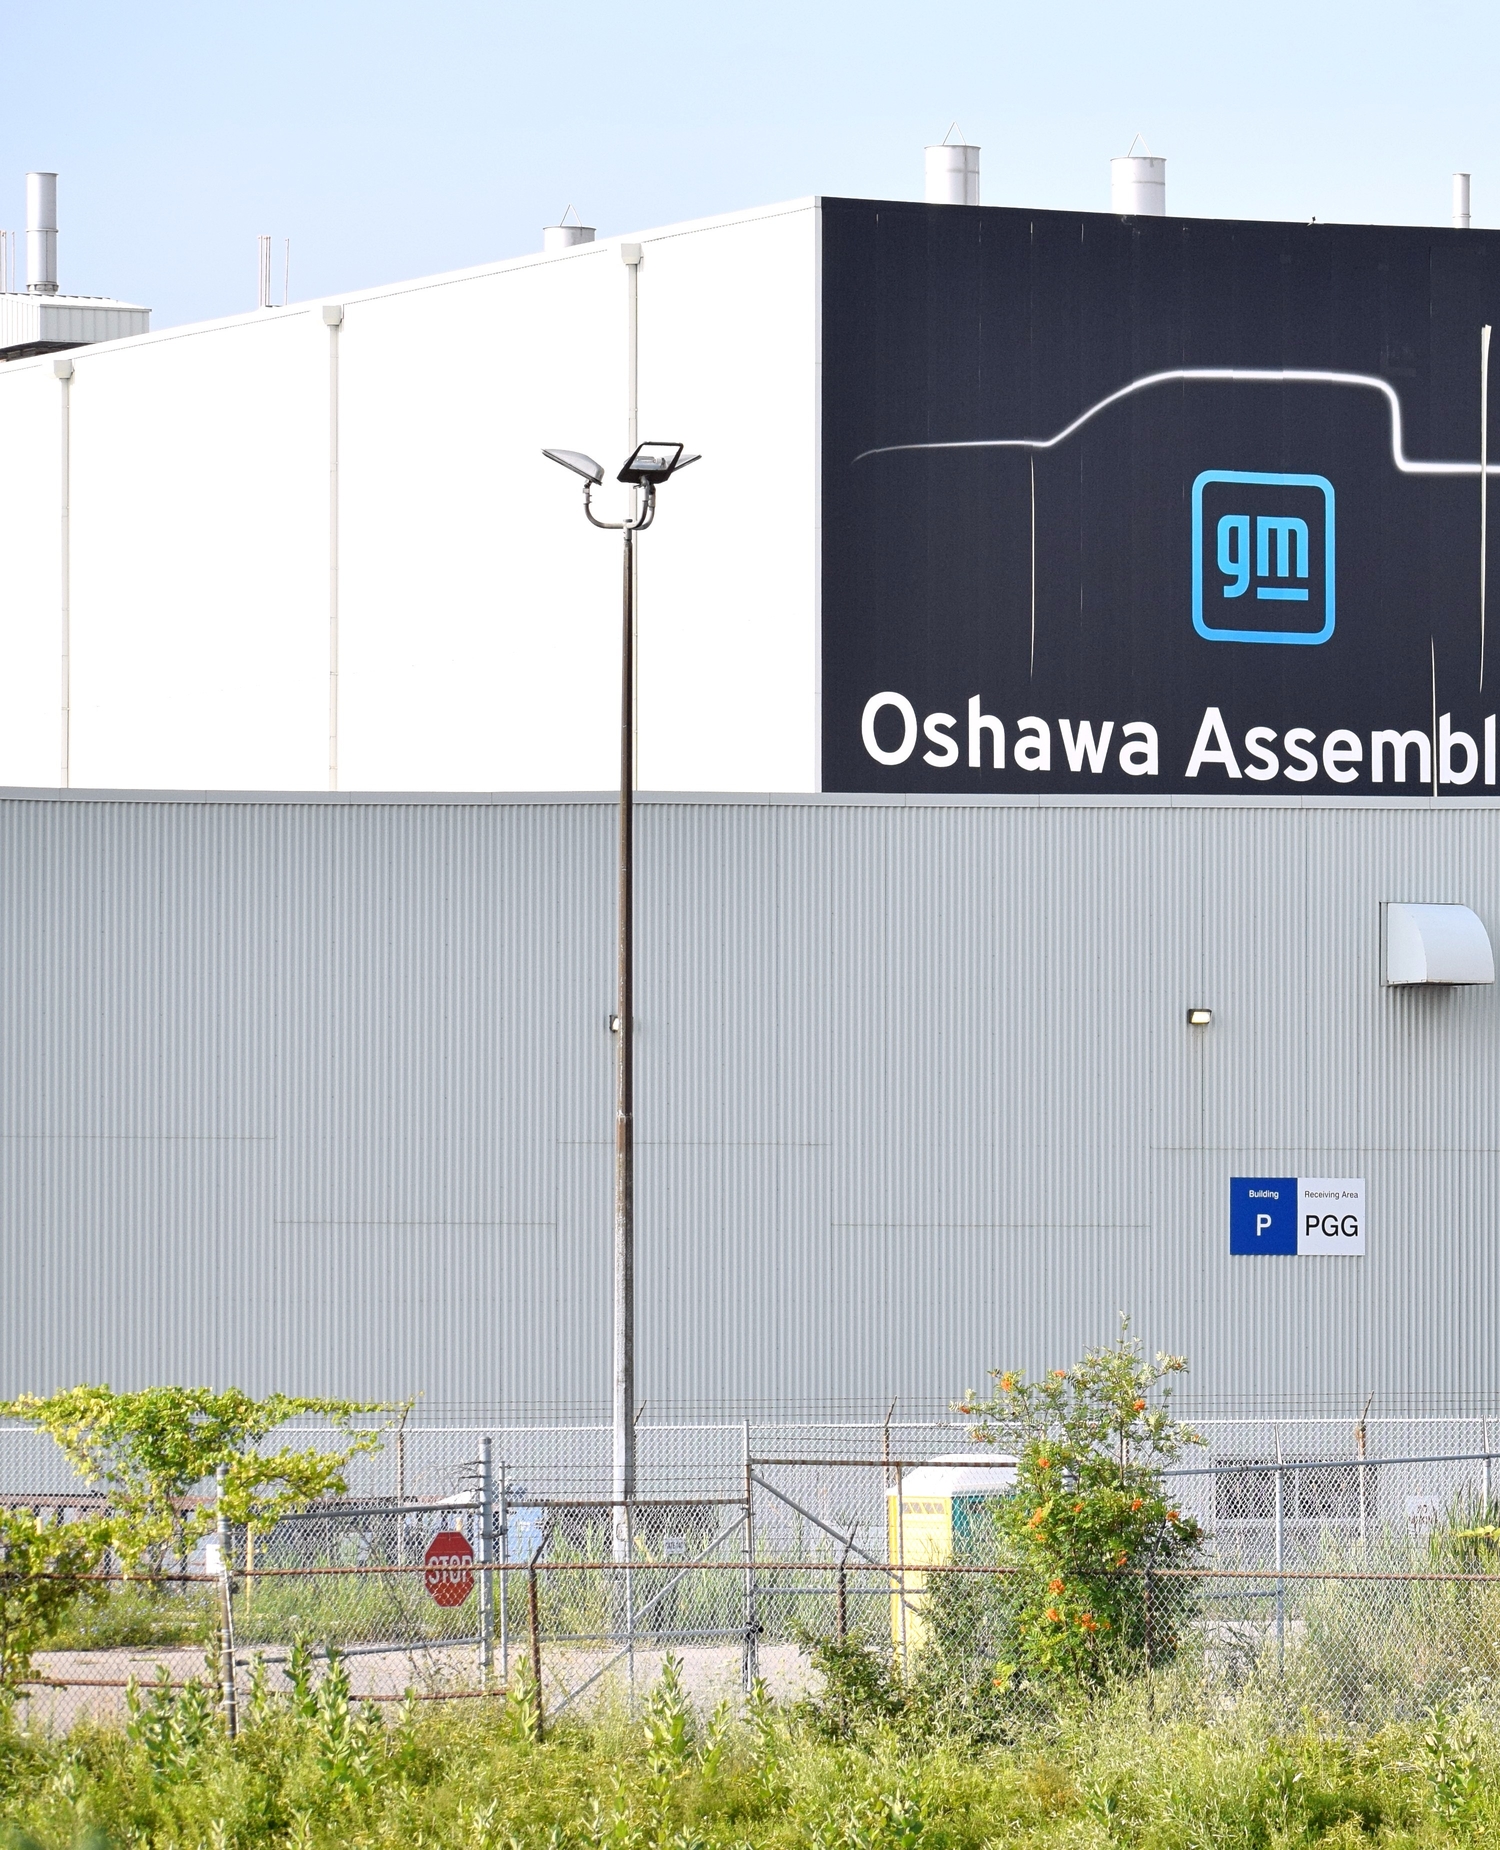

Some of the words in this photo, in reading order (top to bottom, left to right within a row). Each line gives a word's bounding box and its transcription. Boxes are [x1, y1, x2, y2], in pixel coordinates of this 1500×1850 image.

[1217, 514, 1309, 601] gm
[861, 691, 1159, 776] Oshawa
[1249, 1190, 1279, 1200] Building
[1304, 1191, 1339, 1200] Receiving
[1341, 1191, 1359, 1199] Area
[1256, 1213, 1272, 1236] P
[1305, 1214, 1359, 1237] PGG
[428, 1555, 472, 1584] STOP
